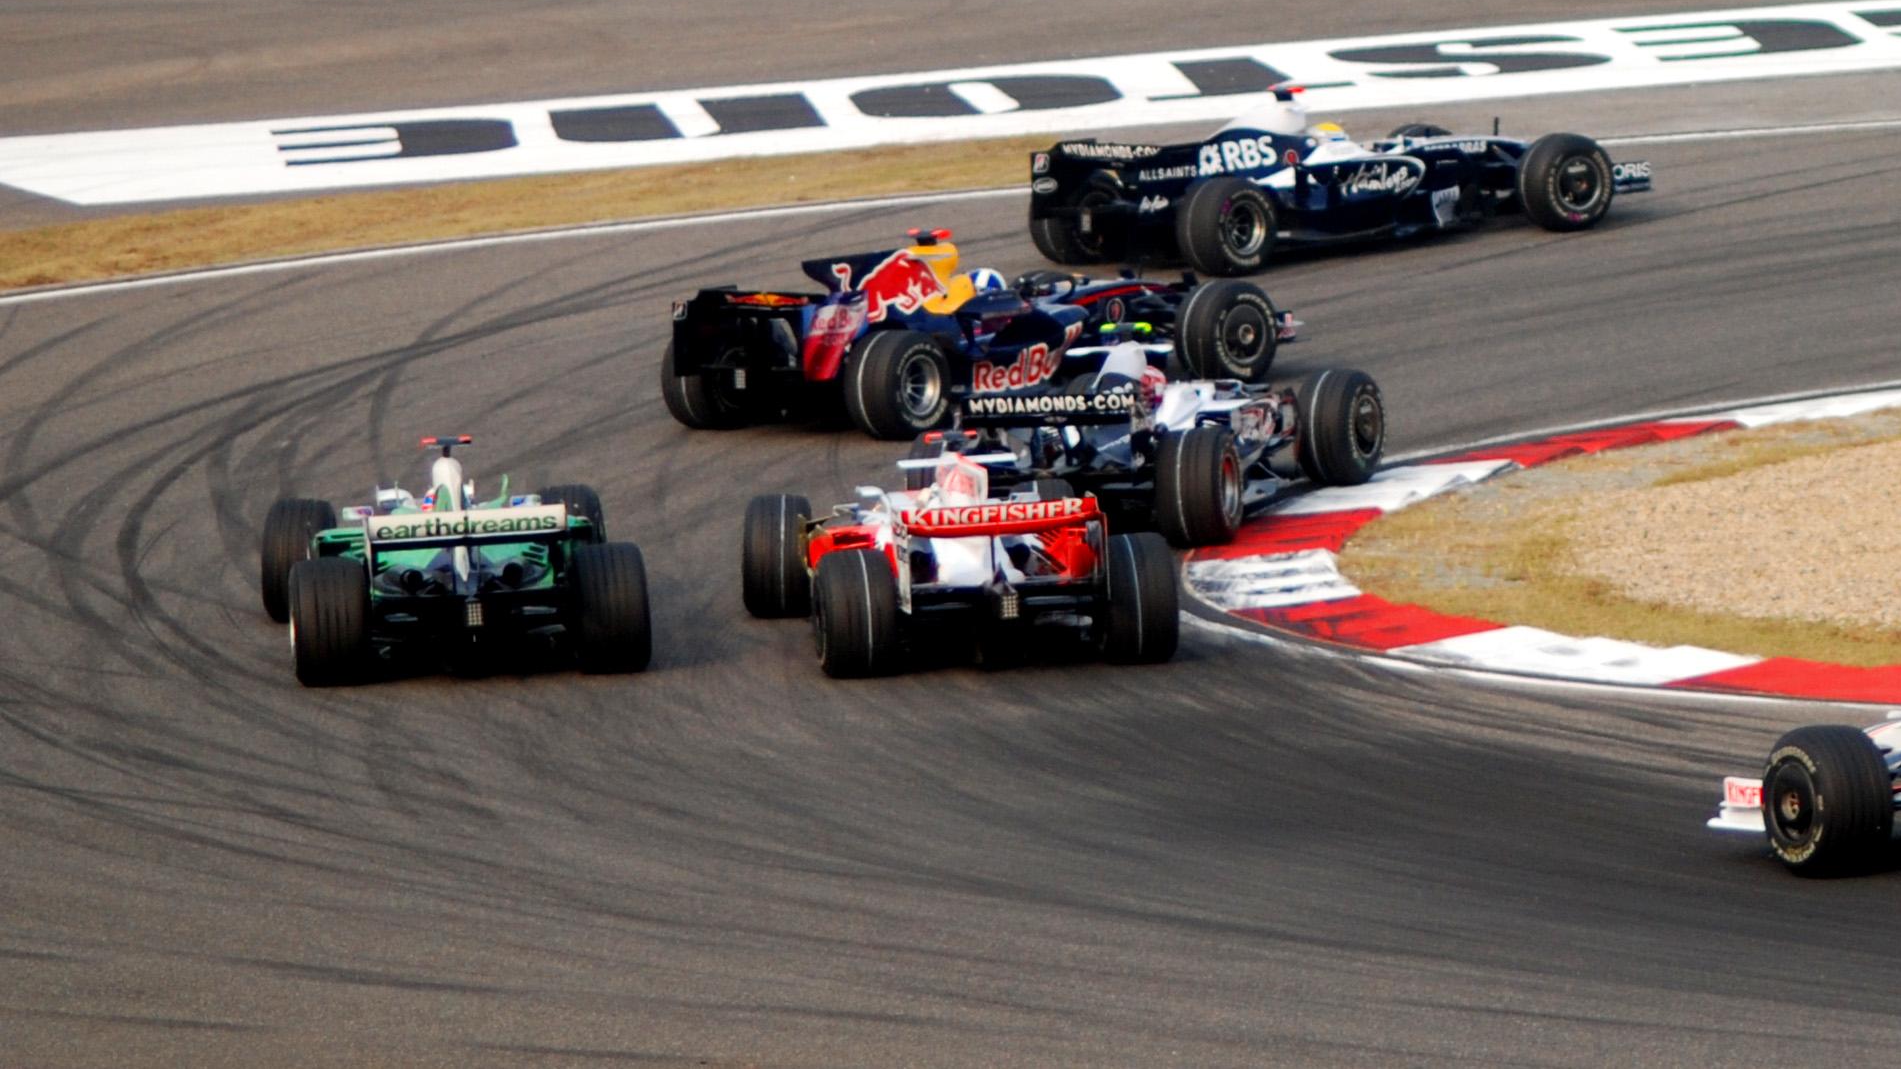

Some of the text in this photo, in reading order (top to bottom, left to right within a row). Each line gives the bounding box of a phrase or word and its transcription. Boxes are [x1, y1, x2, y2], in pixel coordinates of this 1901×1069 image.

[1226, 135, 1278, 172] RBS
[1138, 165, 1198, 181] ALLSAINTS
[377, 512, 558, 541] earthdreams
